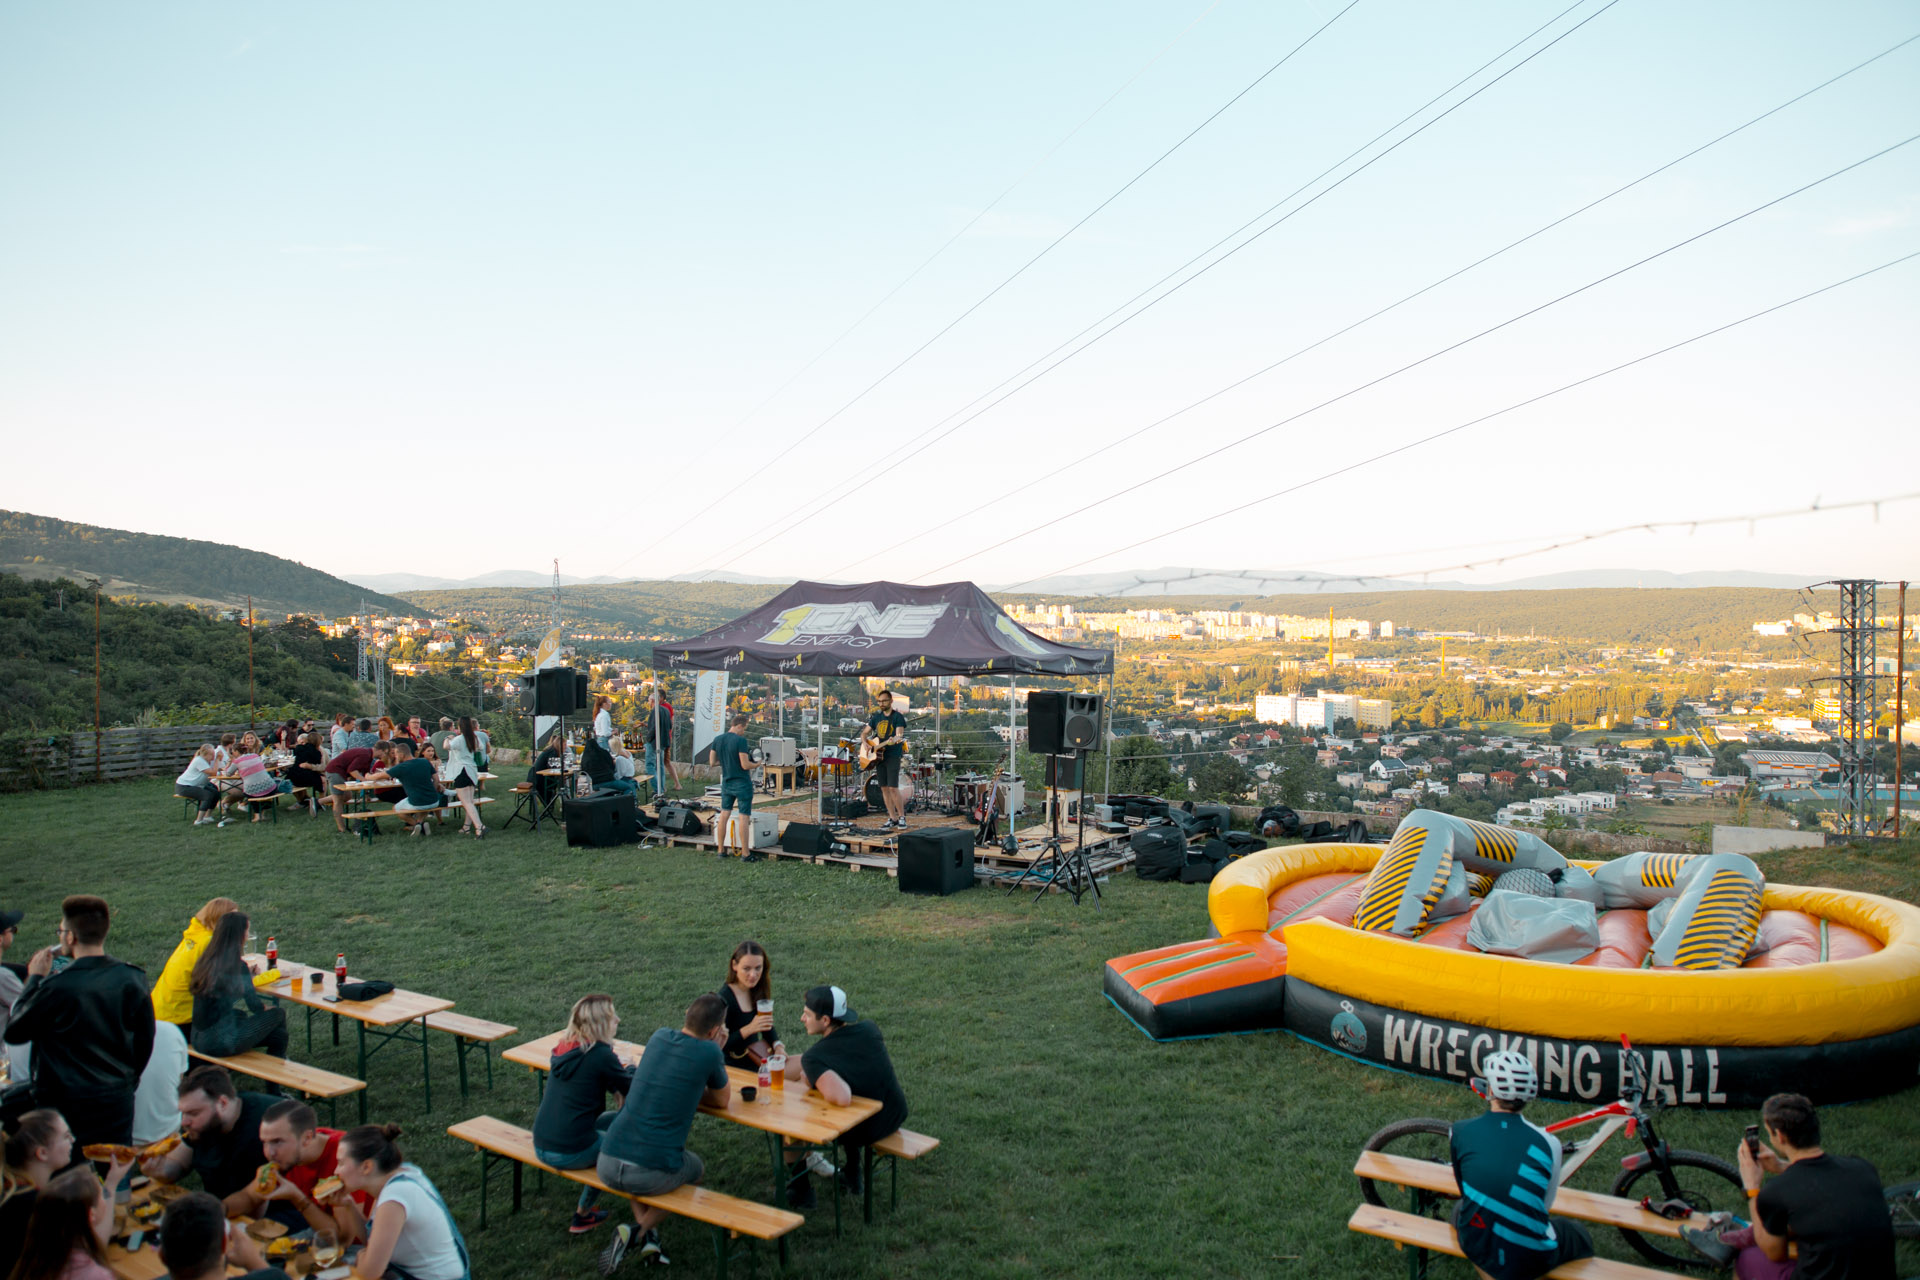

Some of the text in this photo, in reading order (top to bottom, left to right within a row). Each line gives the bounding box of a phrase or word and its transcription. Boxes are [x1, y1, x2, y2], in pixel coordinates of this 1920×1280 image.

[790, 634, 887, 649] ENERGY
[712, 696, 721, 732] GRAND
[1618, 1048, 1727, 1106] BALL
